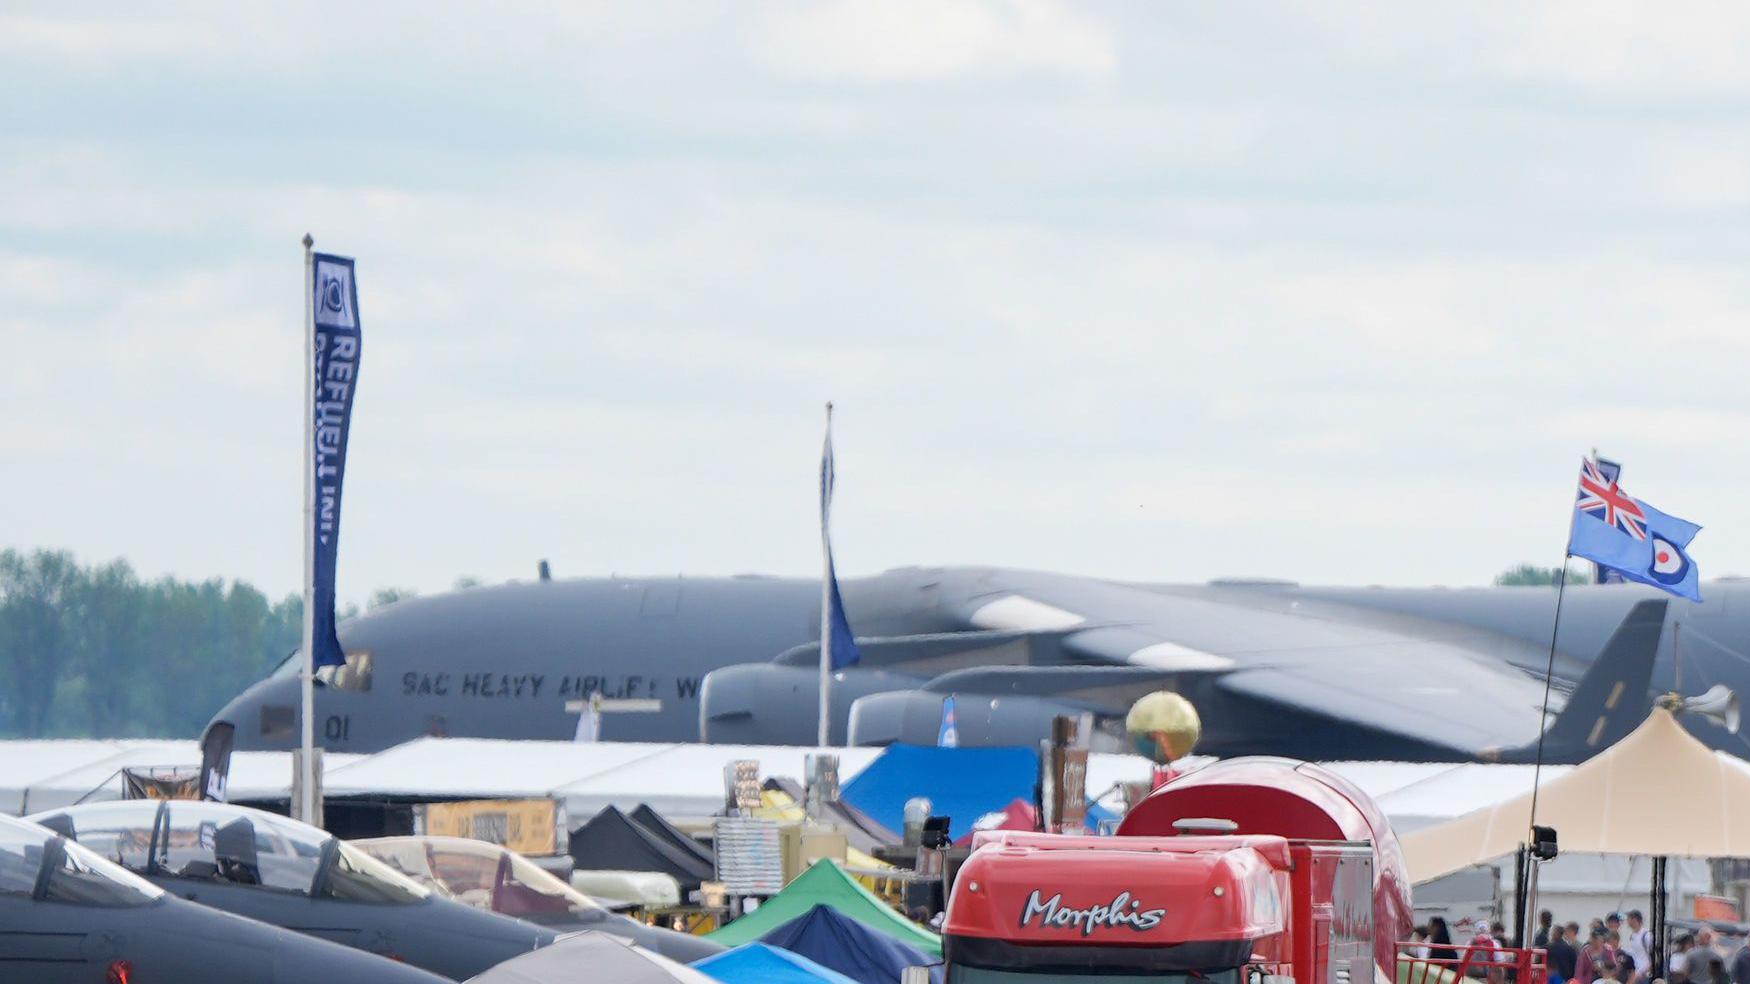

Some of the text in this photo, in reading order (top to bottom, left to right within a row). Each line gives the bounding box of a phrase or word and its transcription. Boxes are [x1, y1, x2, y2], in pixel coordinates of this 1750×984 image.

[402, 672, 451, 697] SAC
[461, 673, 544, 698] HEAVY
[1020, 888, 1167, 937] Morphis
